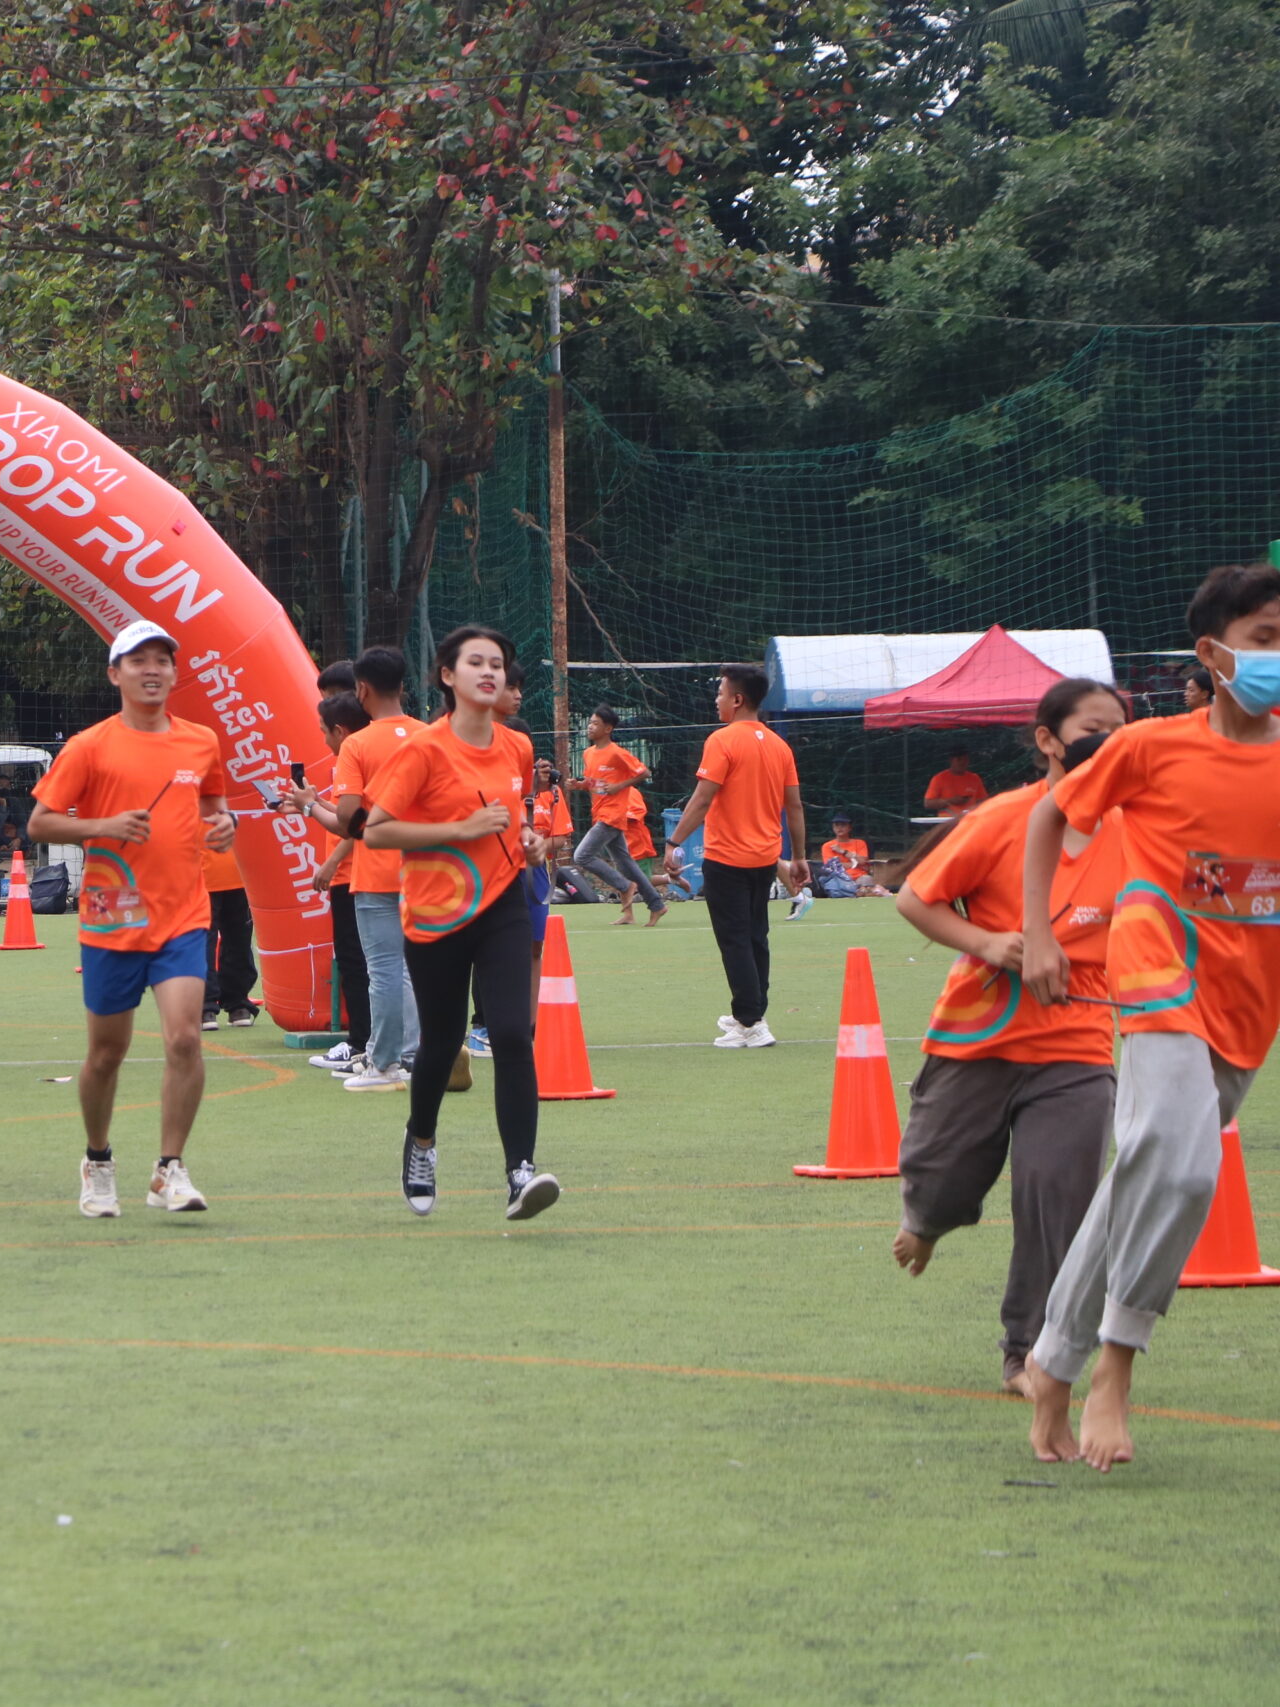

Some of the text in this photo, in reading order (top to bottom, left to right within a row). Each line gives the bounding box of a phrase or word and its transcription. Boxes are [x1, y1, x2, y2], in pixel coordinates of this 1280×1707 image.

[16, 537, 65, 581] YOUR
[60, 573, 131, 631] RUNNIN
[73, 514, 224, 623] RUN
[1251, 896, 1275, 916] 63
